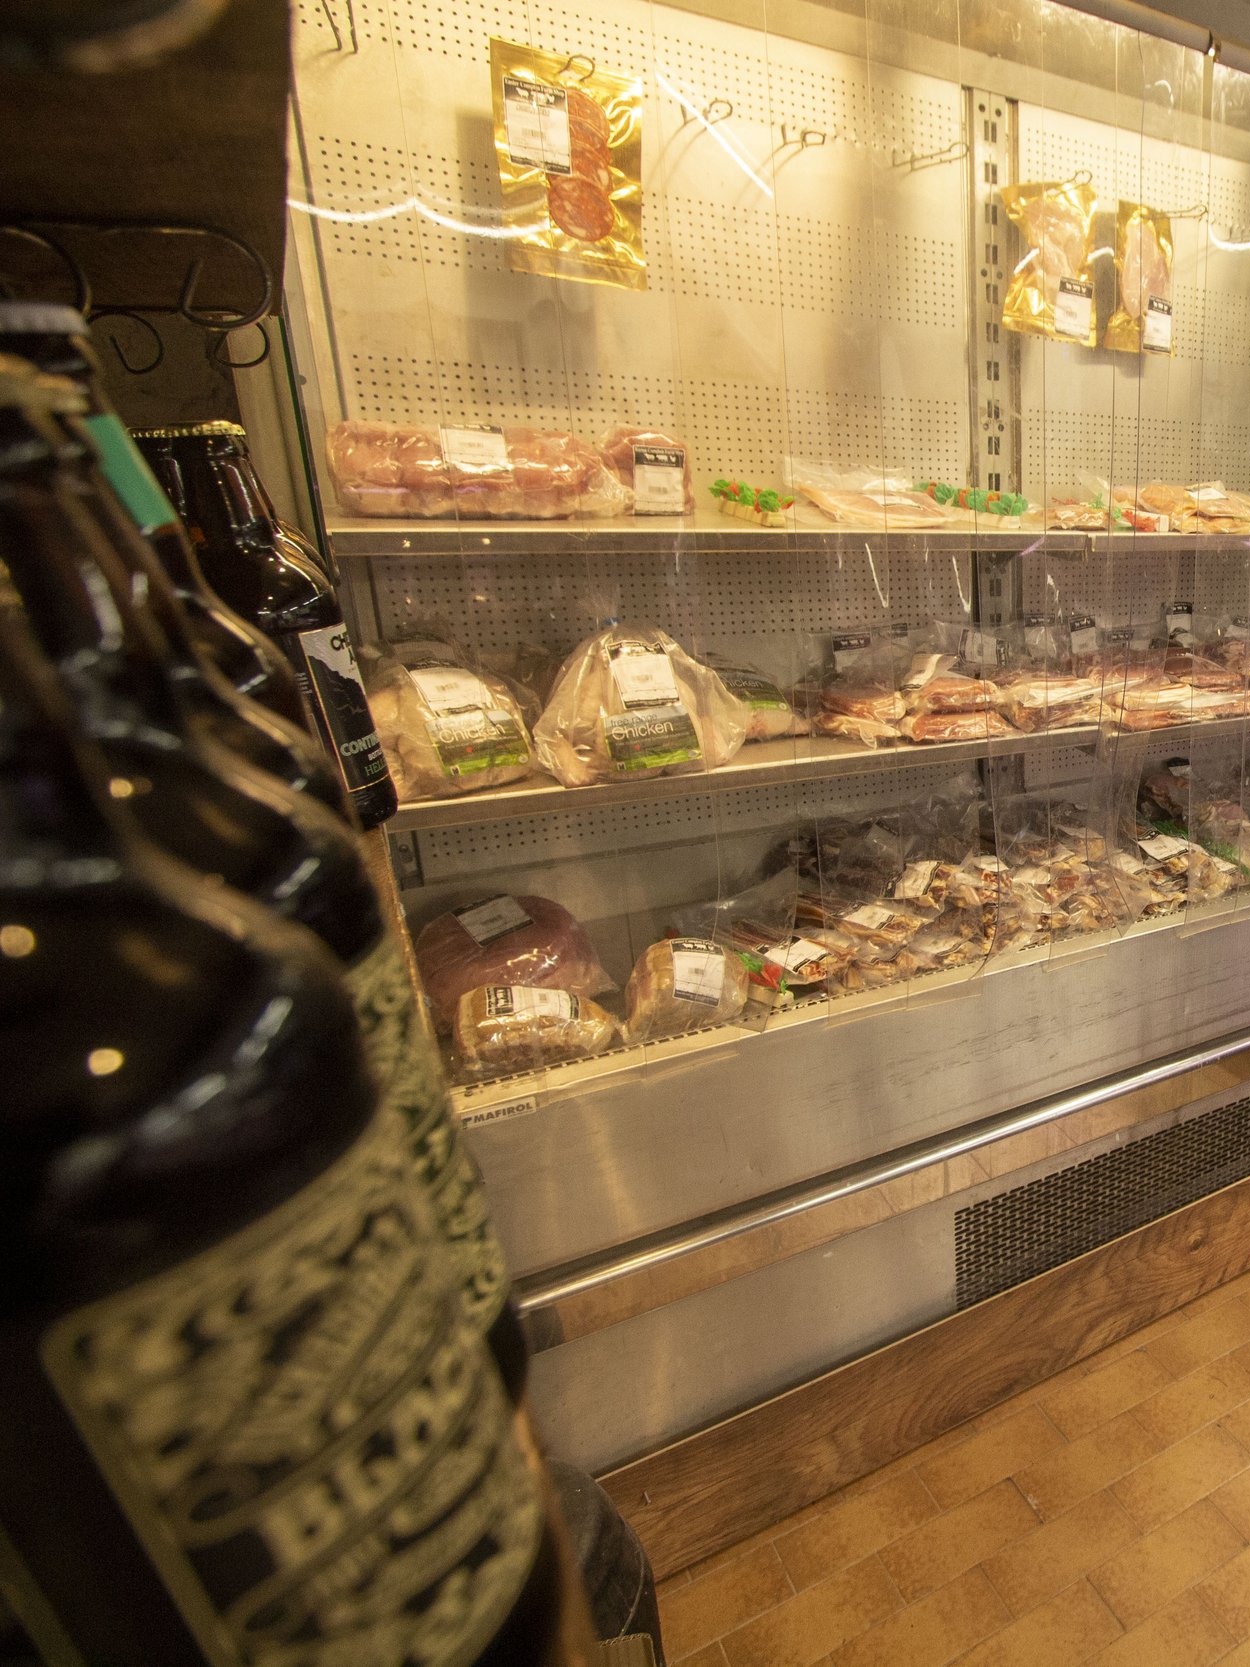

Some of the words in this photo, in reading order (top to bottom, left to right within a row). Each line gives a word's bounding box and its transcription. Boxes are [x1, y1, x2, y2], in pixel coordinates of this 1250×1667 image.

[438, 723, 506, 744] Chicken
[612, 720, 674, 741] Chicken
[473, 1101, 533, 1123] MAFIROL
